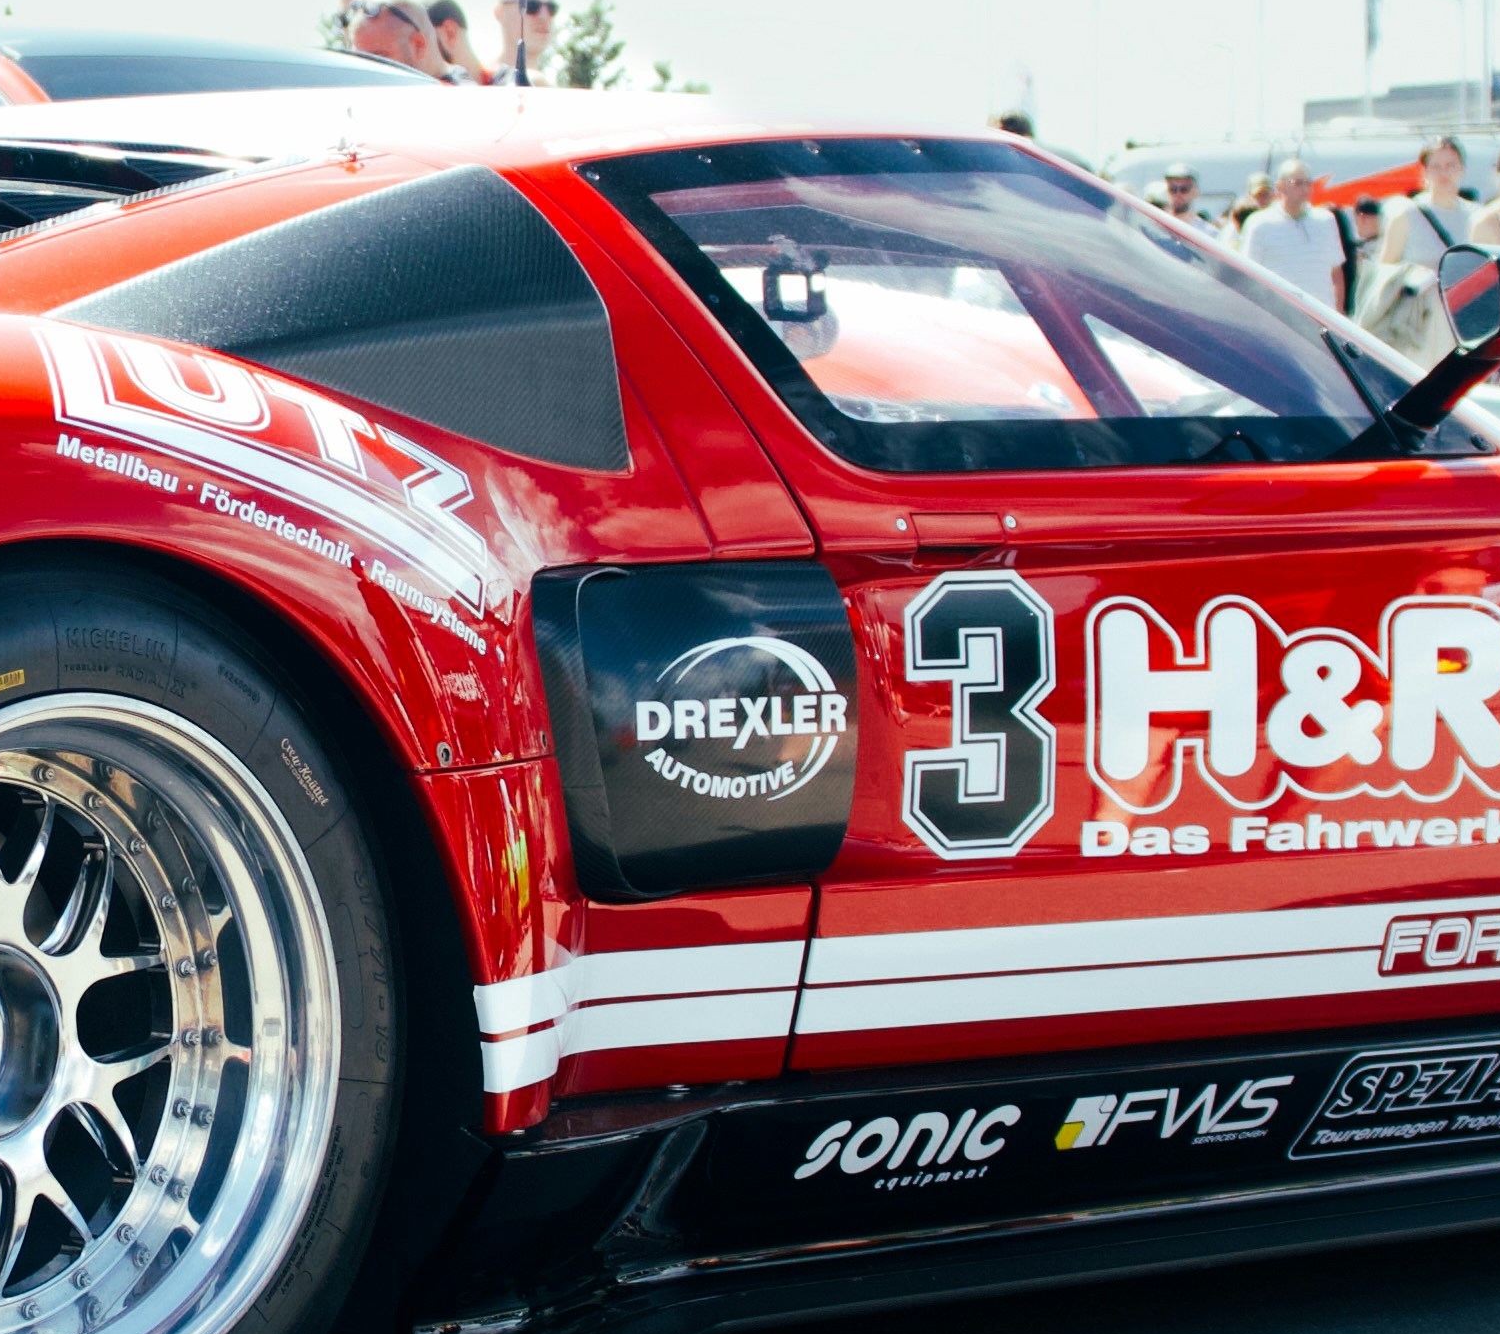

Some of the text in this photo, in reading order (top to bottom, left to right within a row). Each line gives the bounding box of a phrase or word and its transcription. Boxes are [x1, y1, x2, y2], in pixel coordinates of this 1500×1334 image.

[31, 325, 488, 619] LUTZ
[56, 433, 488, 656] Metallbau Fördertechnik Raumsysteme
[64, 626, 169, 662] MICHELIN
[635, 693, 849, 750] DREXLER
[903, 569, 1057, 862] 3
[645, 747, 797, 800] AUTOMOTIVE
[1080, 818, 1210, 857] Das
[1098, 1075, 1296, 1146] FWS
[1311, 1119, 1449, 1146] Tourenwagen
[873, 1165, 989, 1192] equipment
